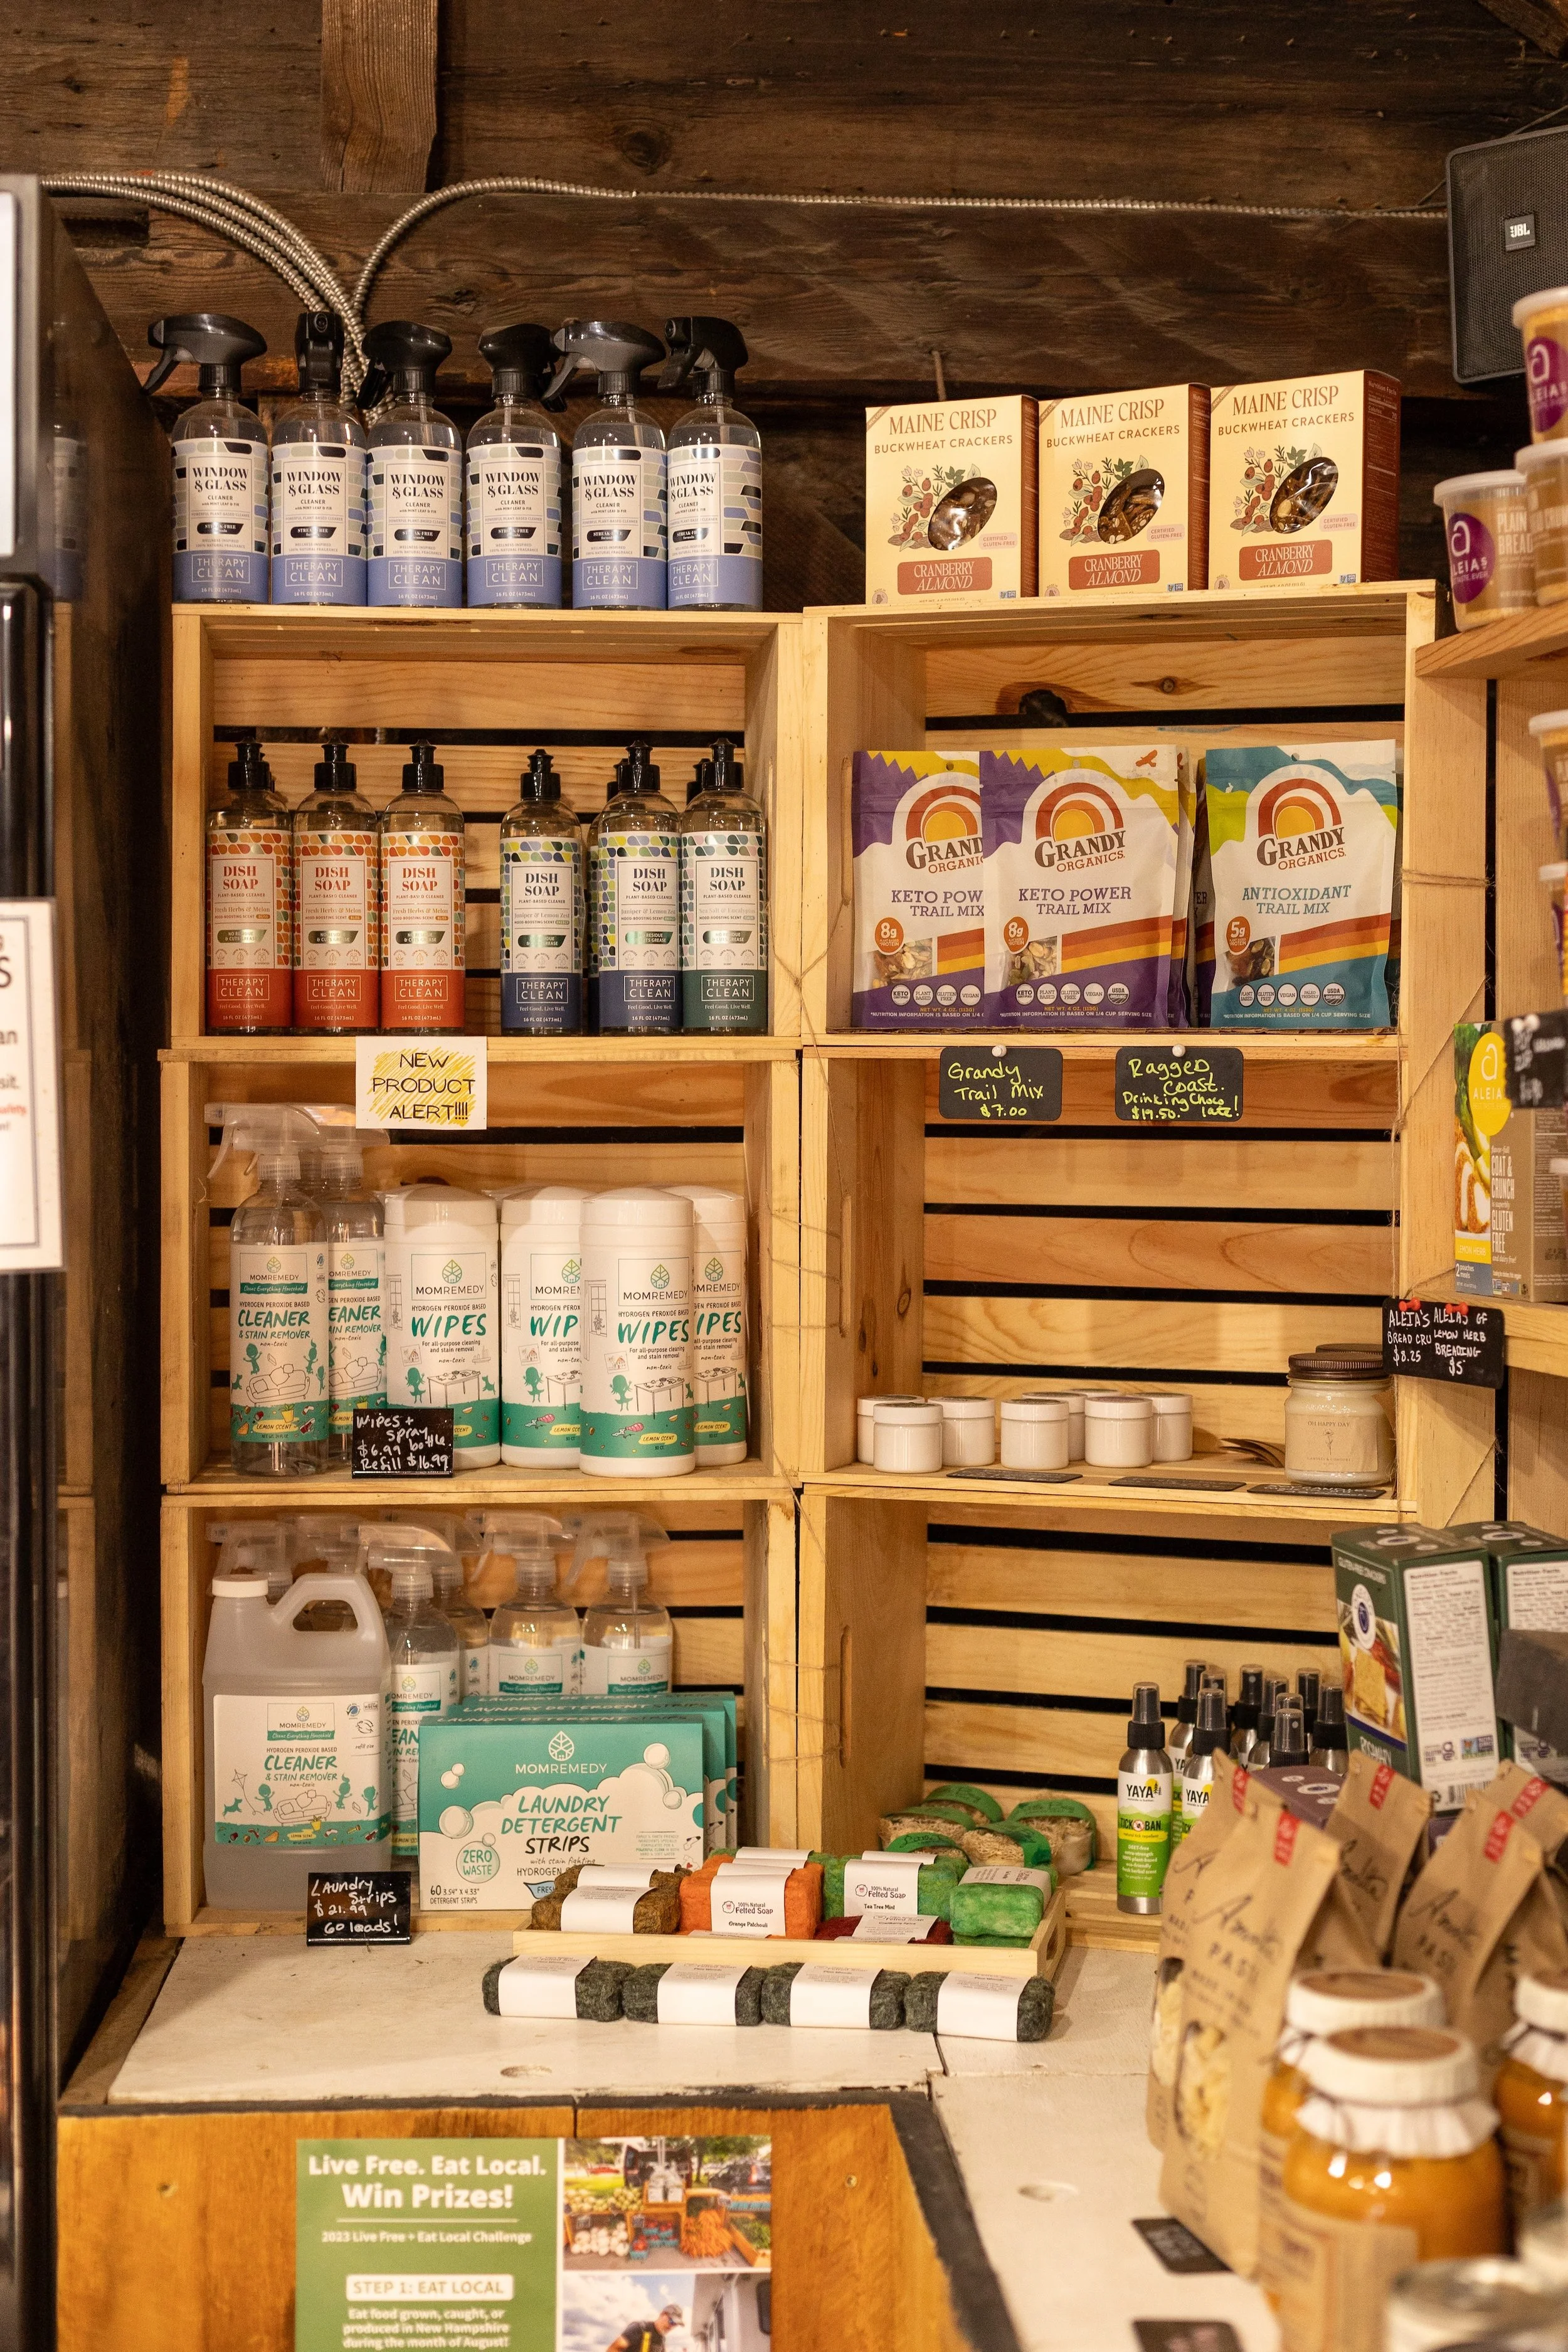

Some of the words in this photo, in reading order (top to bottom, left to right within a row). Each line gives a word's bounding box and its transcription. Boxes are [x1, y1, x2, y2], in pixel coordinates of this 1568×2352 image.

[1510, 223, 1530, 238] JBL
[1232, 391, 1286, 415] MAINE
[1292, 386, 1338, 408] CRISP
[1061, 405, 1113, 428] MAINE
[1119, 398, 1164, 421] CRISP
[889, 413, 944, 435] MAINE
[950, 409, 996, 430] CRISP
[1218, 420, 1287, 436] BUCKWHEAT
[1292, 412, 1354, 426] CRACKERS
[1047, 431, 1114, 448] BUCKWHEAT
[1118, 425, 1180, 439] CRACKERS
[875, 440, 945, 454] BUCKWHEAT
[950, 435, 1012, 448] CRACKERS
[193, 468, 248, 479] WINDOW
[287, 472, 342, 482] WINDOW
[485, 473, 540, 483] WINDOW
[583, 475, 637, 486] WINDOW
[670, 474, 715, 486] WINDOW
[1255, 544, 1314, 562] CRANBERRY
[197, 558, 245, 567] THERAPY
[914, 561, 974, 576] CRANBERRY
[1258, 559, 1313, 576] ALMOND
[197, 568, 244, 578] CLEAN
[916, 575, 972, 591] ALMOND
[1035, 830, 1126, 868] GRANDY
[1257, 827, 1345, 866] GRANDY
[223, 866, 256, 876] DISH
[526, 873, 558, 883] DISH
[711, 867, 743, 877] DISH
[223, 880, 258, 889] SOAP
[525, 886, 559, 896] SOAP
[710, 881, 744, 891] SOAP
[1019, 889, 1065, 901] KETO
[1069, 887, 1131, 901] POWER
[1242, 885, 1352, 901] ANTIOXIDANT
[1037, 903, 1079, 914] TRAIL
[1083, 903, 1111, 914] MIX
[1256, 903, 1300, 914] TRAIL
[1303, 903, 1329, 913] MIX
[1009, 921, 1024, 936] 8g
[1231, 921, 1246, 938] 5g
[707, 988, 749, 997] CLEAN
[400, 1053, 449, 1068] NEW
[948, 1062, 1020, 1084] Grandy
[373, 1078, 475, 1094] PRODUCT
[955, 1085, 998, 1101] Trail
[1011, 1079, 1043, 1098] Mix
[1123, 1091, 1189, 1111] Drinking
[389, 1102, 468, 1120] ALERT!!!!
[980, 1104, 1027, 1118] $7.00
[1491, 1156, 1505, 1177] COAT
[1491, 1179, 1515, 1200] CRUNCH
[1491, 1209, 1513, 1232] GLUTEN
[1457, 1244, 1471, 1254] LEMON
[1473, 1246, 1486, 1256] HERB
[1492, 1232, 1505, 1253] FREE
[416, 1285, 484, 1295] MOMREMEDY
[623, 1290, 687, 1300] MOMREMEDY
[238, 1310, 310, 1327] CLEANER
[412, 1314, 487, 1338] WIPES
[1389, 1310, 1430, 1327] ALEIA'S
[270, 1330, 310, 1339] REMOVER
[618, 1320, 689, 1344] WIPES
[1387, 1332, 1412, 1344] BREAD
[1416, 1335, 1431, 1345] CRU
[1434, 1330, 1458, 1339] LEMON
[1463, 1330, 1486, 1342] HERB
[1393, 1345, 1421, 1367] $8.25
[358, 1440, 401, 1458] $6.99
[407, 1454, 448, 1472] $16.99
[264, 1756, 337, 1772] CLEANER
[516, 1764, 607, 1774] MOMREMEDY
[300, 1772, 337, 1781] REMOVER
[1126, 1784, 1153, 1798] YAYA
[1186, 1789, 1209, 1804] YAYA
[518, 1796, 610, 1813] LAUNDRY
[501, 1816, 623, 1835] DETERGENT
[1121, 1818, 1133, 1830] TICK
[1145, 1820, 1161, 1830] BAN
[525, 1836, 590, 1855] STRIPS
[463, 1850, 492, 1863] ZERO
[463, 1865, 492, 1876] WASTE
[324, 1922, 344, 1934] 60
[309, 2155, 359, 2175] Live
[366, 2156, 425, 2175] Free.
[432, 2156, 470, 2175] Eat
[476, 2155, 546, 2175] Local.
[342, 2183, 403, 2208] Win
[412, 2183, 513, 2208] Prizes!
[354, 2282, 393, 2294] STEP
[400, 2282, 412, 2294] 1:
[418, 2282, 447, 2294] EAT
[452, 2282, 503, 2294] LOCAL
